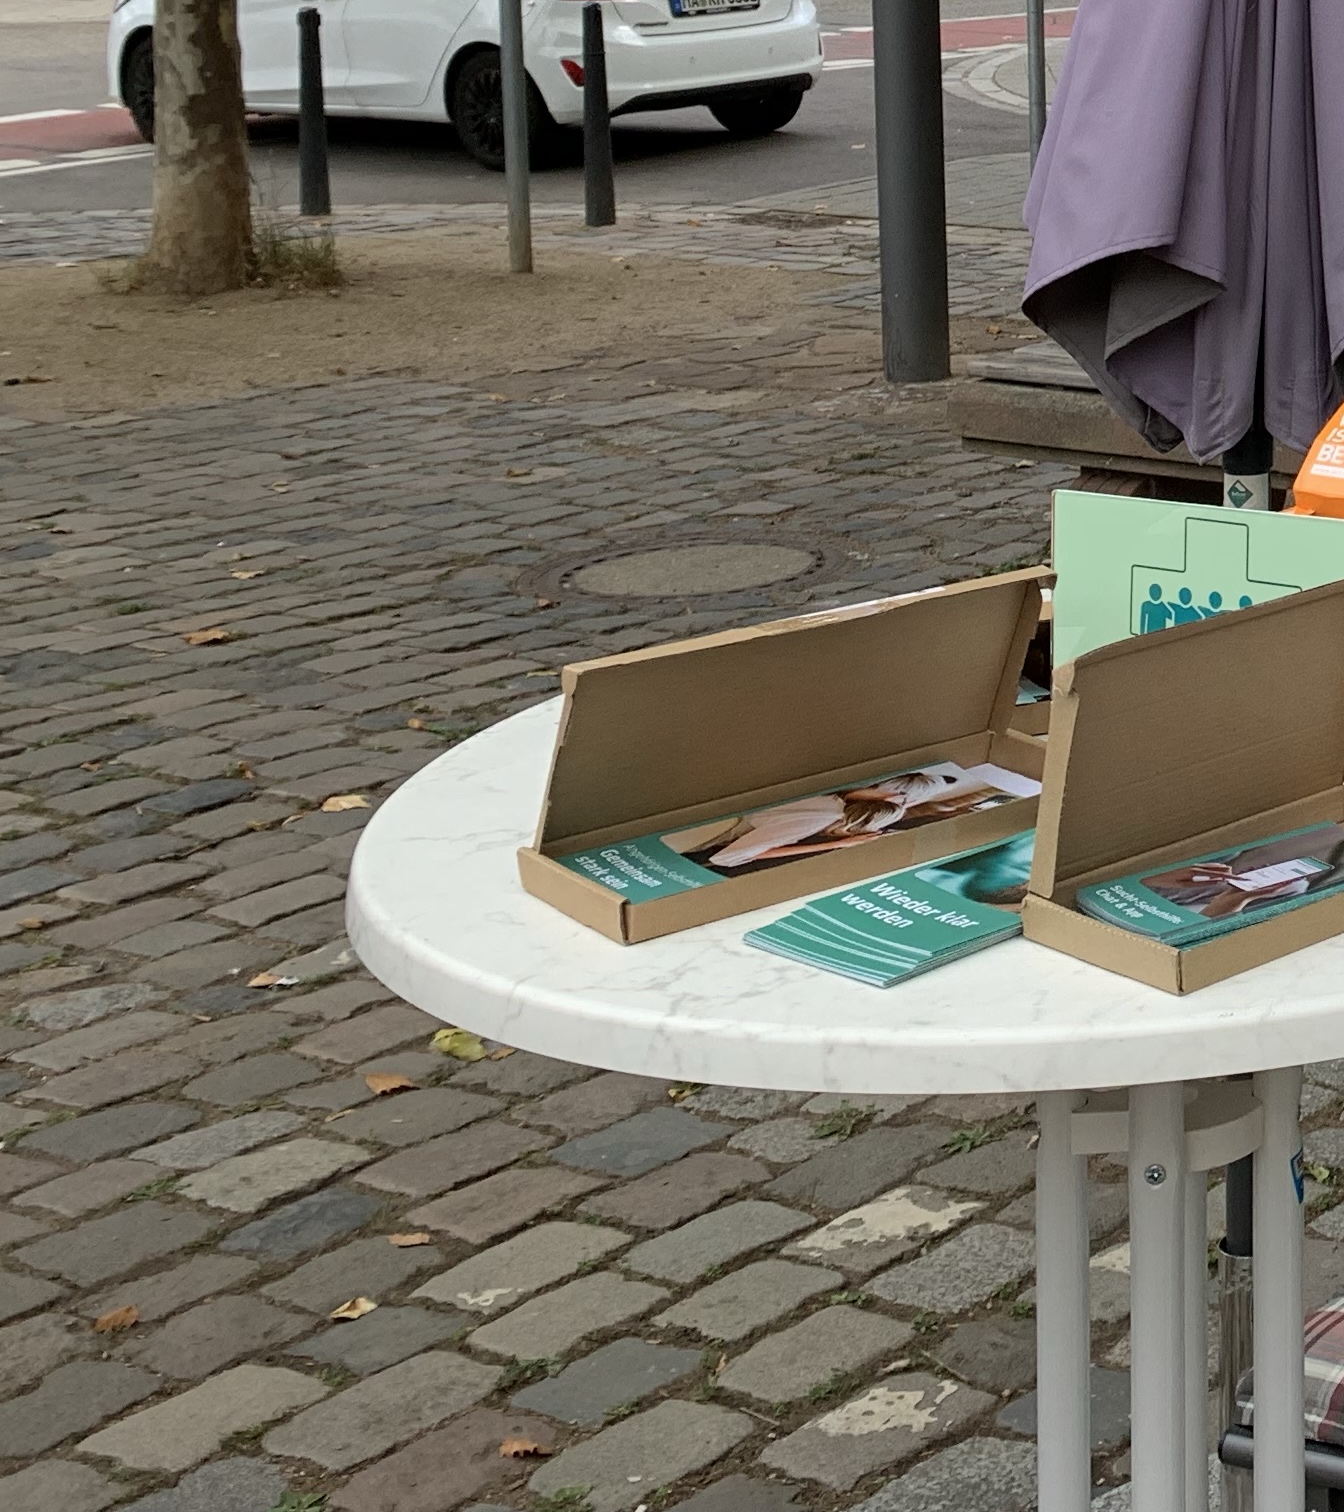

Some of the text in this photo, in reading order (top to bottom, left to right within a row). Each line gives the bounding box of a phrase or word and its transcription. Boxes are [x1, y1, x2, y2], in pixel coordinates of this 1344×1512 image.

[575, 855, 610, 877] stark
[600, 874, 629, 890] sein
[600, 849, 662, 888] Gemeinsam
[841, 893, 913, 928] werden
[870, 882, 980, 928] Wieder klar
[1095, 888, 1120, 905] Chat
